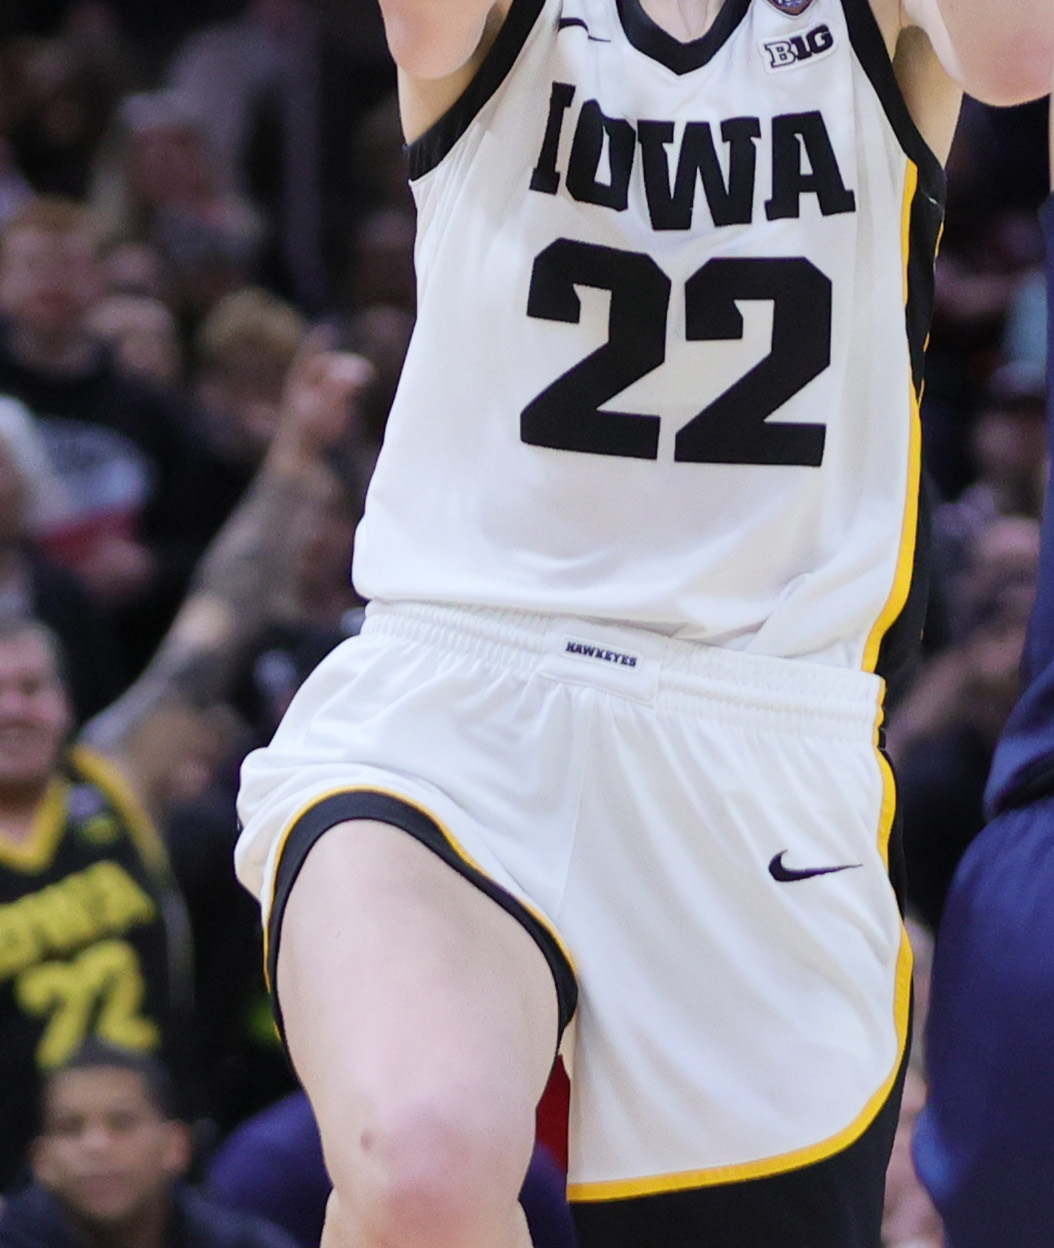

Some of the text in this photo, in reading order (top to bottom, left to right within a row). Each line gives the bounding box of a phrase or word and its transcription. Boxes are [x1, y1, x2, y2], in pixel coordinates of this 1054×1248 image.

[529, 81, 856, 231] IOWA
[520, 237, 832, 467] 22
[565, 641, 638, 667] HAWKEYES
